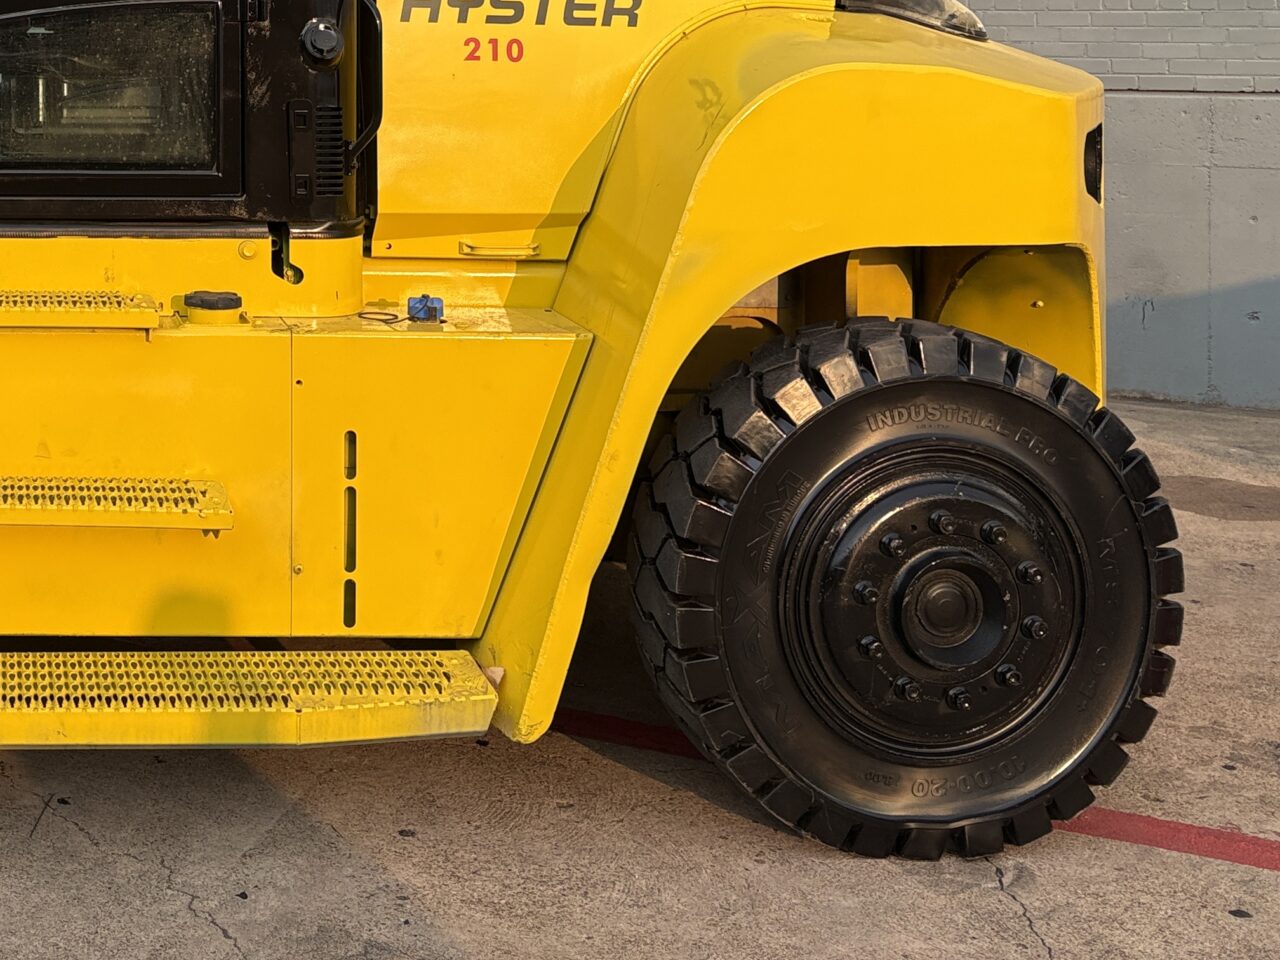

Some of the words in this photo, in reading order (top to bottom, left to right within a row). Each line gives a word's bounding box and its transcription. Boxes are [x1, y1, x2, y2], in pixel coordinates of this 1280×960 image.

[463, 37, 524, 63] 210
[866, 403, 1011, 436] INDUSTRIAL
[1015, 427, 1059, 465] PRO
